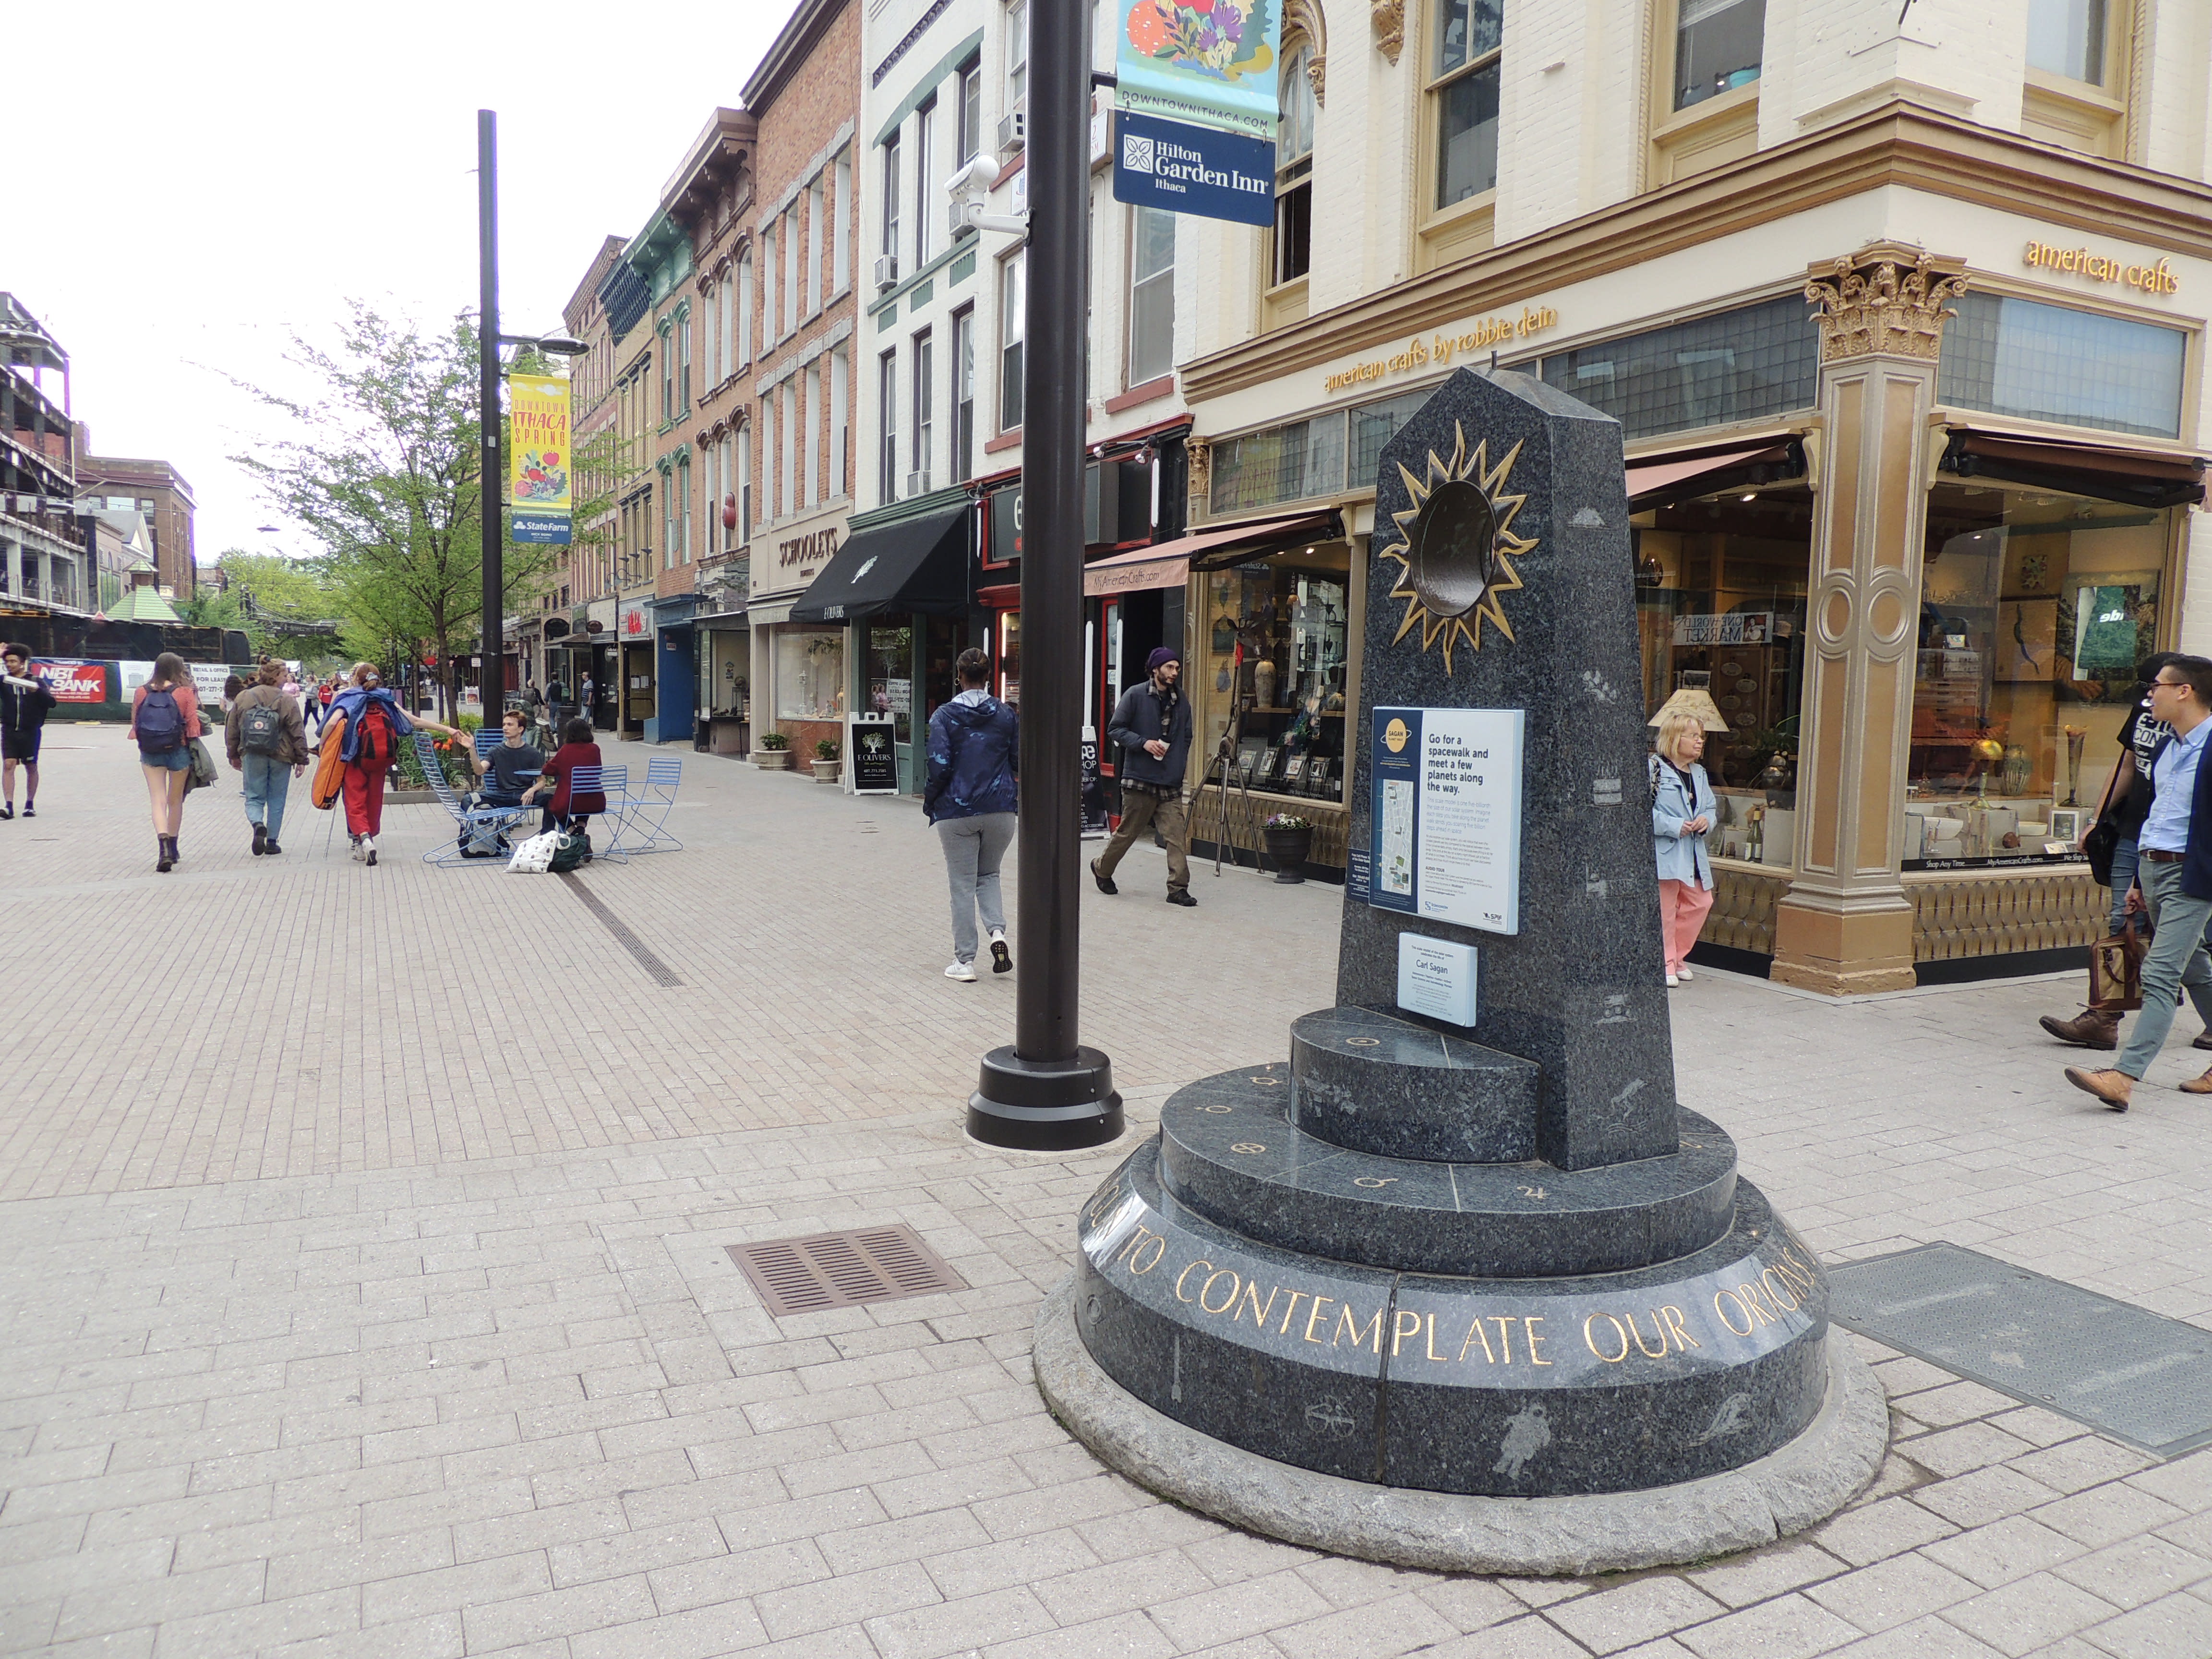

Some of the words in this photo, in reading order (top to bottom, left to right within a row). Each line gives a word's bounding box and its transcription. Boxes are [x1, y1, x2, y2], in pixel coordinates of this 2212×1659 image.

[1122, 90, 1268, 129] DOWNTOWNITHACA.COM
[1156, 141, 1202, 163] Hilton
[1155, 157, 1229, 188] Garden
[1155, 178, 1186, 193] Ithaca
[2023, 240, 2121, 283] american
[2124, 256, 2180, 295] crafts
[1324, 361, 1384, 392] american
[1388, 338, 1428, 372] crafts
[1433, 335, 1456, 365] by
[1457, 317, 1513, 352] robbie
[1517, 306, 1558, 337] dein
[515, 399, 565, 412] DOWNTOWN
[514, 411, 566, 431] ITHACA
[515, 428, 565, 446] SPRING
[780, 527, 837, 568] SCHOOLEYS
[1094, 568, 1159, 591] MyAmericanCrafts.com
[827, 605, 844, 618] OLIVERS
[39, 667, 78, 679] NBT
[49, 679, 101, 692] BANK
[1429, 733, 1440, 744] Go
[1443, 734, 1455, 745] for
[1429, 747, 1470, 758] spacewalk
[1472, 748, 1488, 758] and
[1082, 760, 1097, 769] HOP
[1428, 759, 1448, 768] meet
[1457, 759, 1472, 769] few
[1428, 769, 1457, 781] planets
[1460, 772, 1483, 786] along
[1427, 781, 1440, 792] the
[1443, 784, 1460, 796] way.
[1926, 860, 1939, 869] Shop
[1939, 860, 1951, 869] Any
[1416, 960, 1428, 969] Carl
[1430, 962, 1448, 974] Sagan
[1117, 1225, 1166, 1275] TO
[1176, 1260, 1553, 1366] CONTEMPLATE
[1584, 1305, 1701, 1363] OUR
